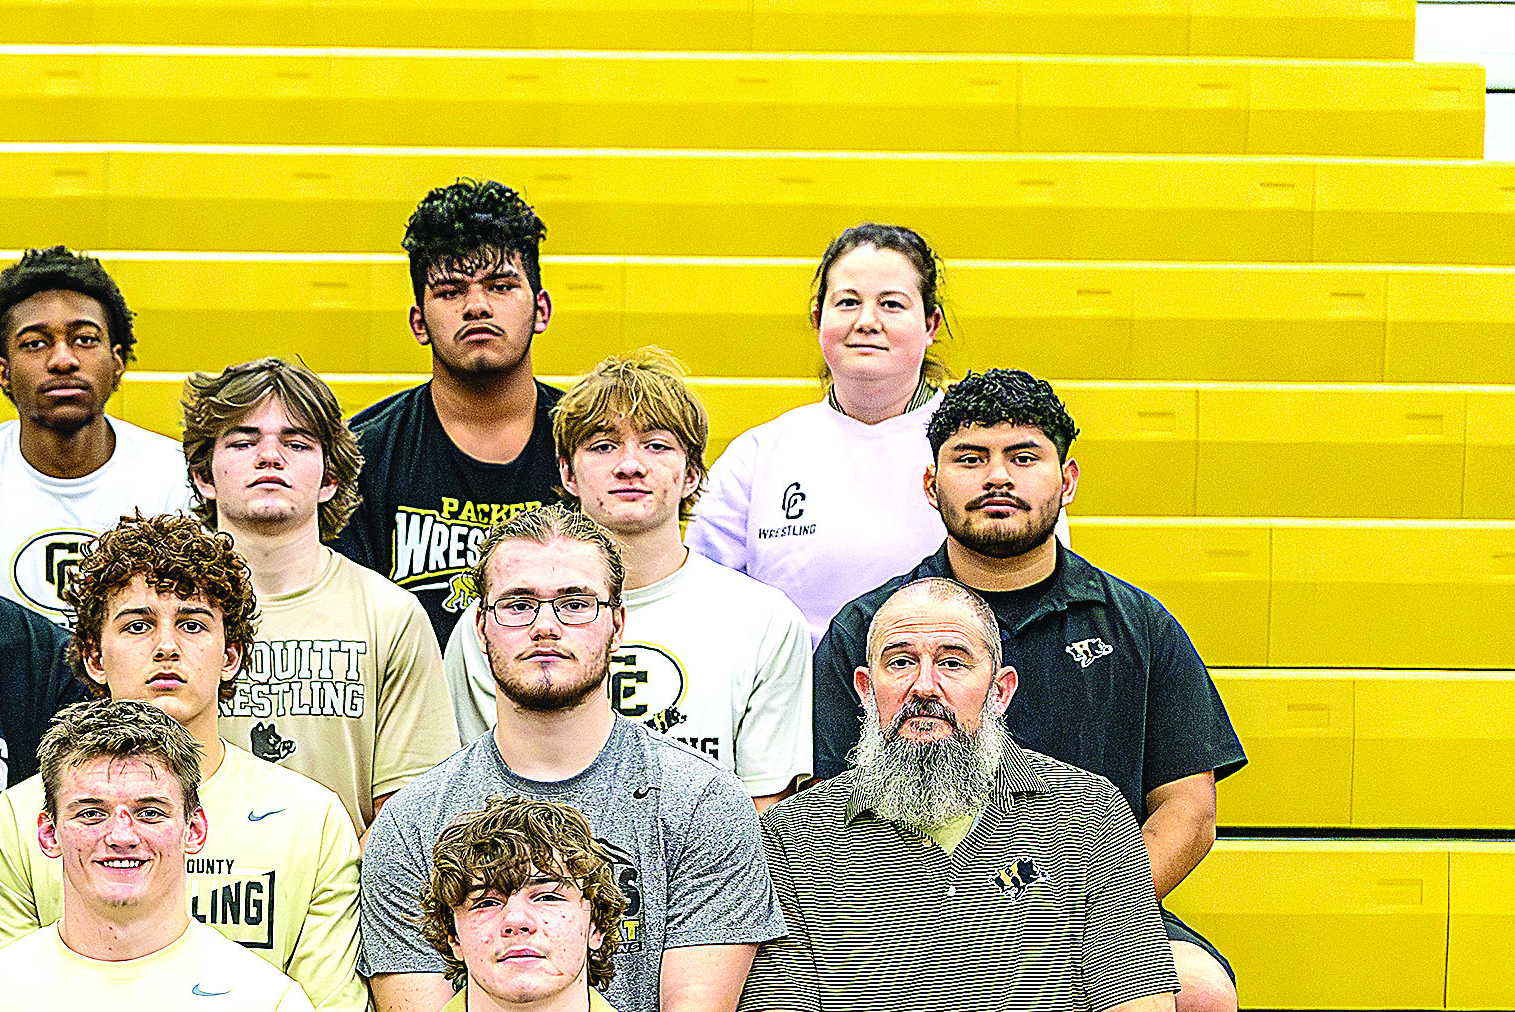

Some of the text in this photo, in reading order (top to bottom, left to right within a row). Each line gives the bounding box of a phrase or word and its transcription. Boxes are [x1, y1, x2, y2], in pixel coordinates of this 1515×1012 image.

[758, 523, 817, 540] WRESTLING
[247, 639, 367, 684] QUITT
[220, 680, 366, 719] ESTLING
[186, 858, 235, 875] OUNTY
